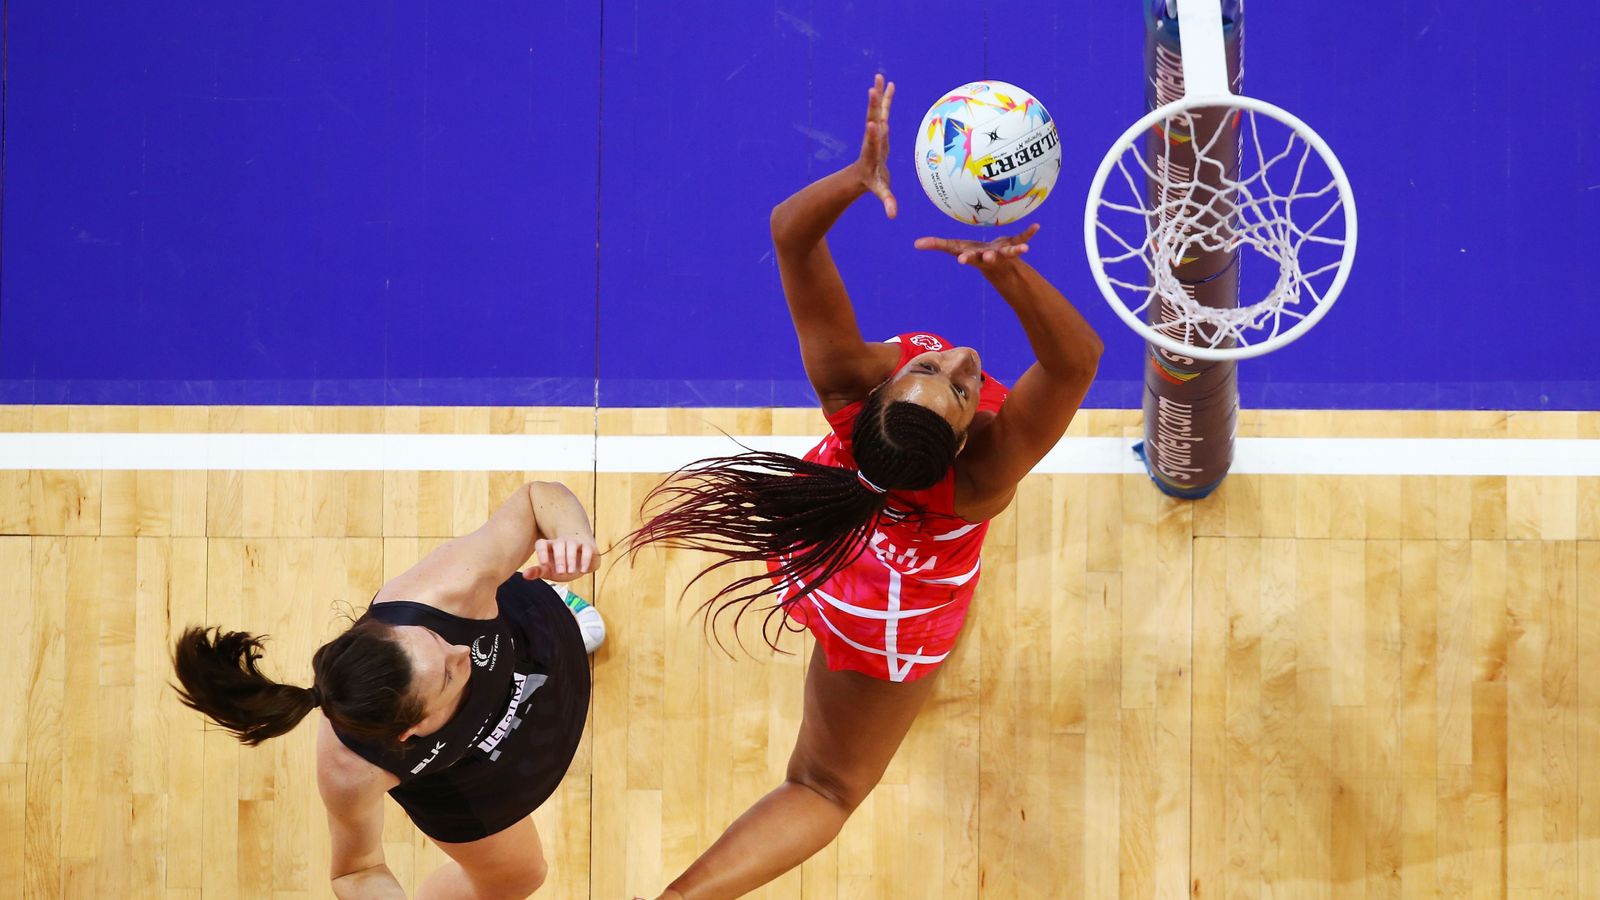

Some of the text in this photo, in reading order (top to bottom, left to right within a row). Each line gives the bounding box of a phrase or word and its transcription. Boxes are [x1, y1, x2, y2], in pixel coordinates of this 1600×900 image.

[1149, 395, 1204, 481] sydney.com
[488, 652, 498, 672] SILVER
[410, 740, 447, 774] BLK
